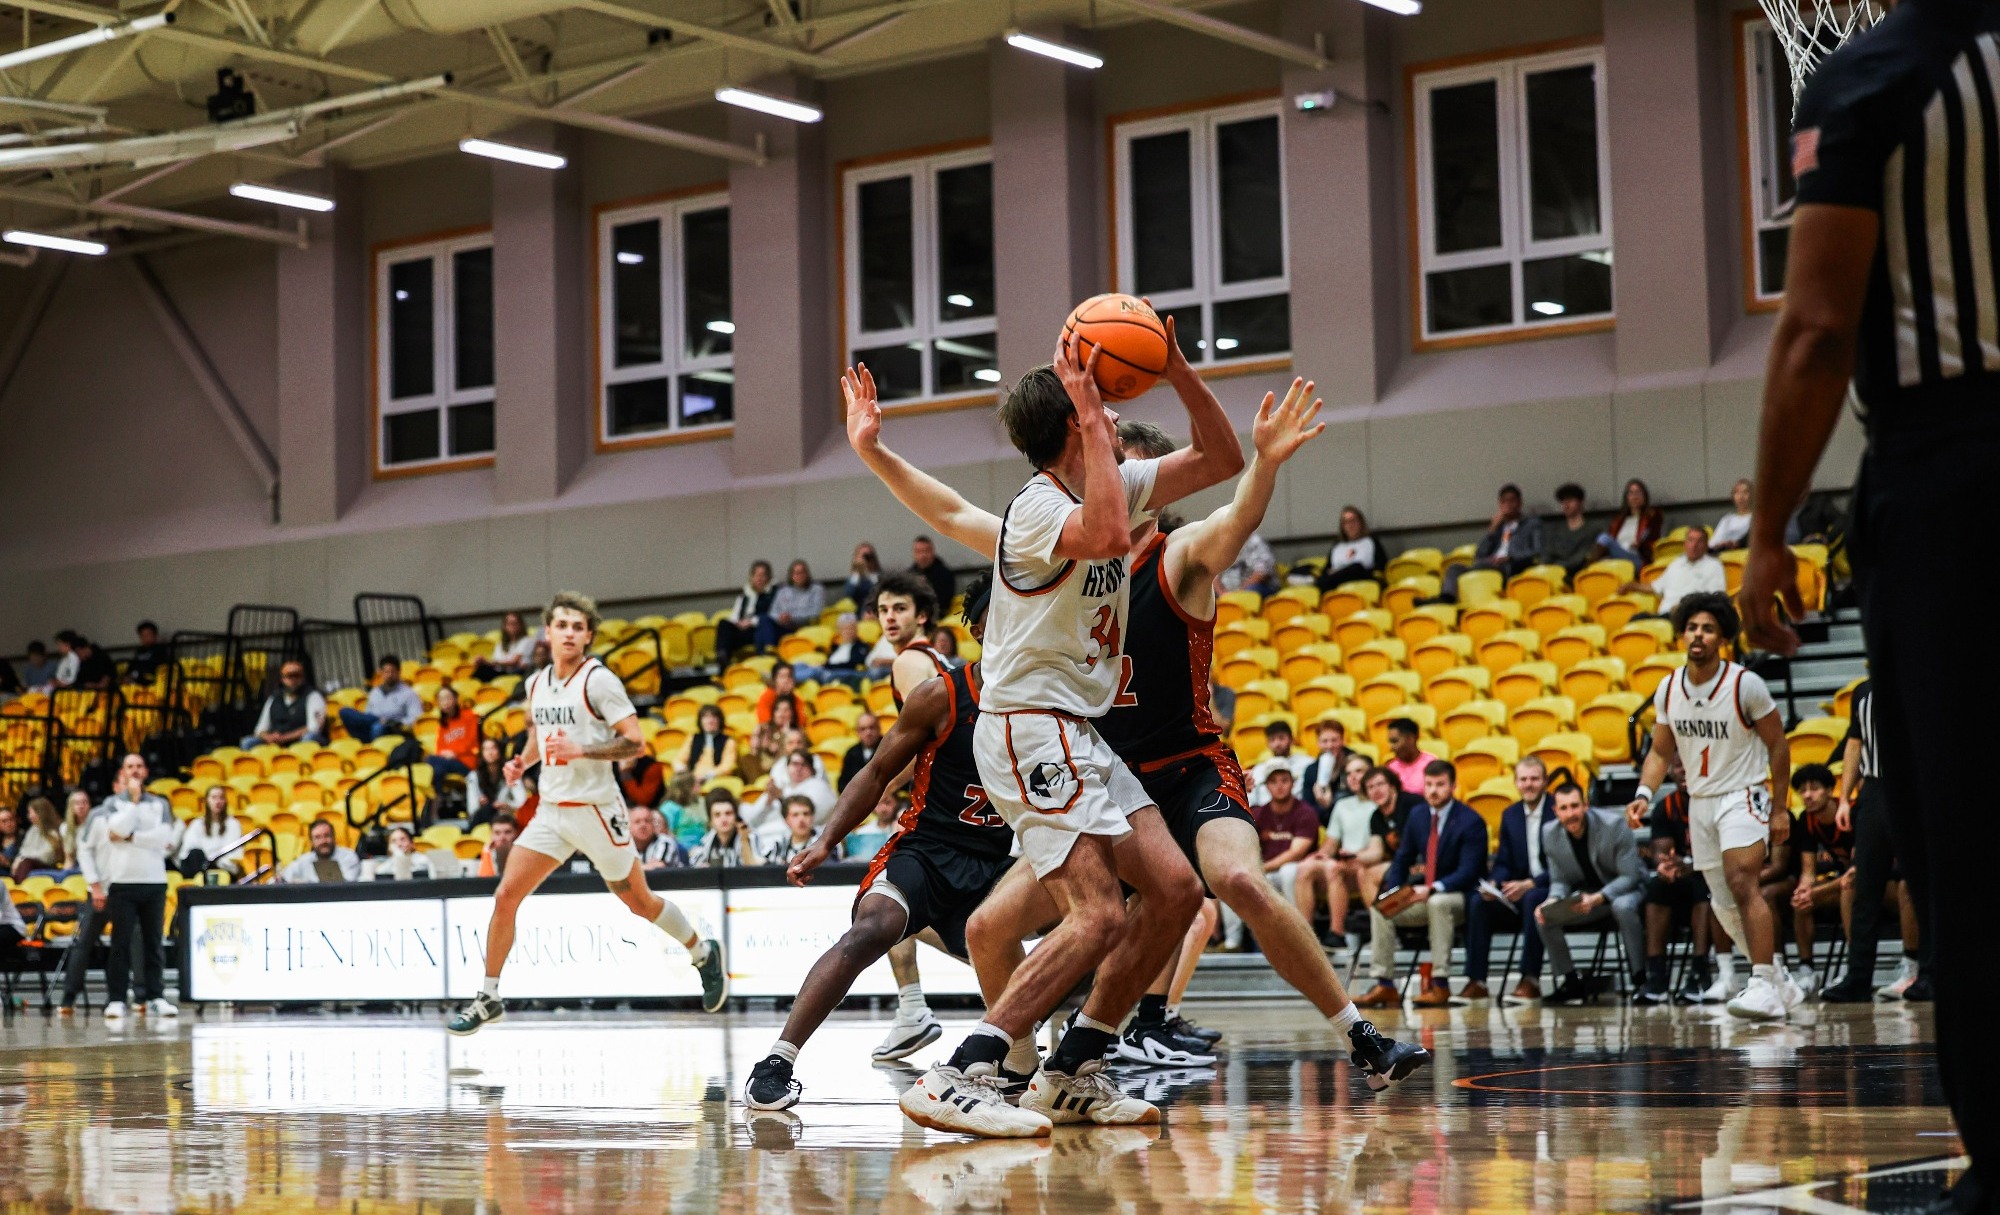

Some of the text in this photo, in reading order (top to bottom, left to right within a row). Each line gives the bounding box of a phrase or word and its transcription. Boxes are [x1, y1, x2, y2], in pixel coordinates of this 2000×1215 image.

[1086, 604, 1120, 666] 34
[535, 706, 576, 725] HENDRIX
[1674, 719, 1728, 740] HENDRIX
[1699, 744, 1709, 778] 1
[264, 926, 438, 971] HENDRIX
[454, 924, 639, 966] WRRIORS
